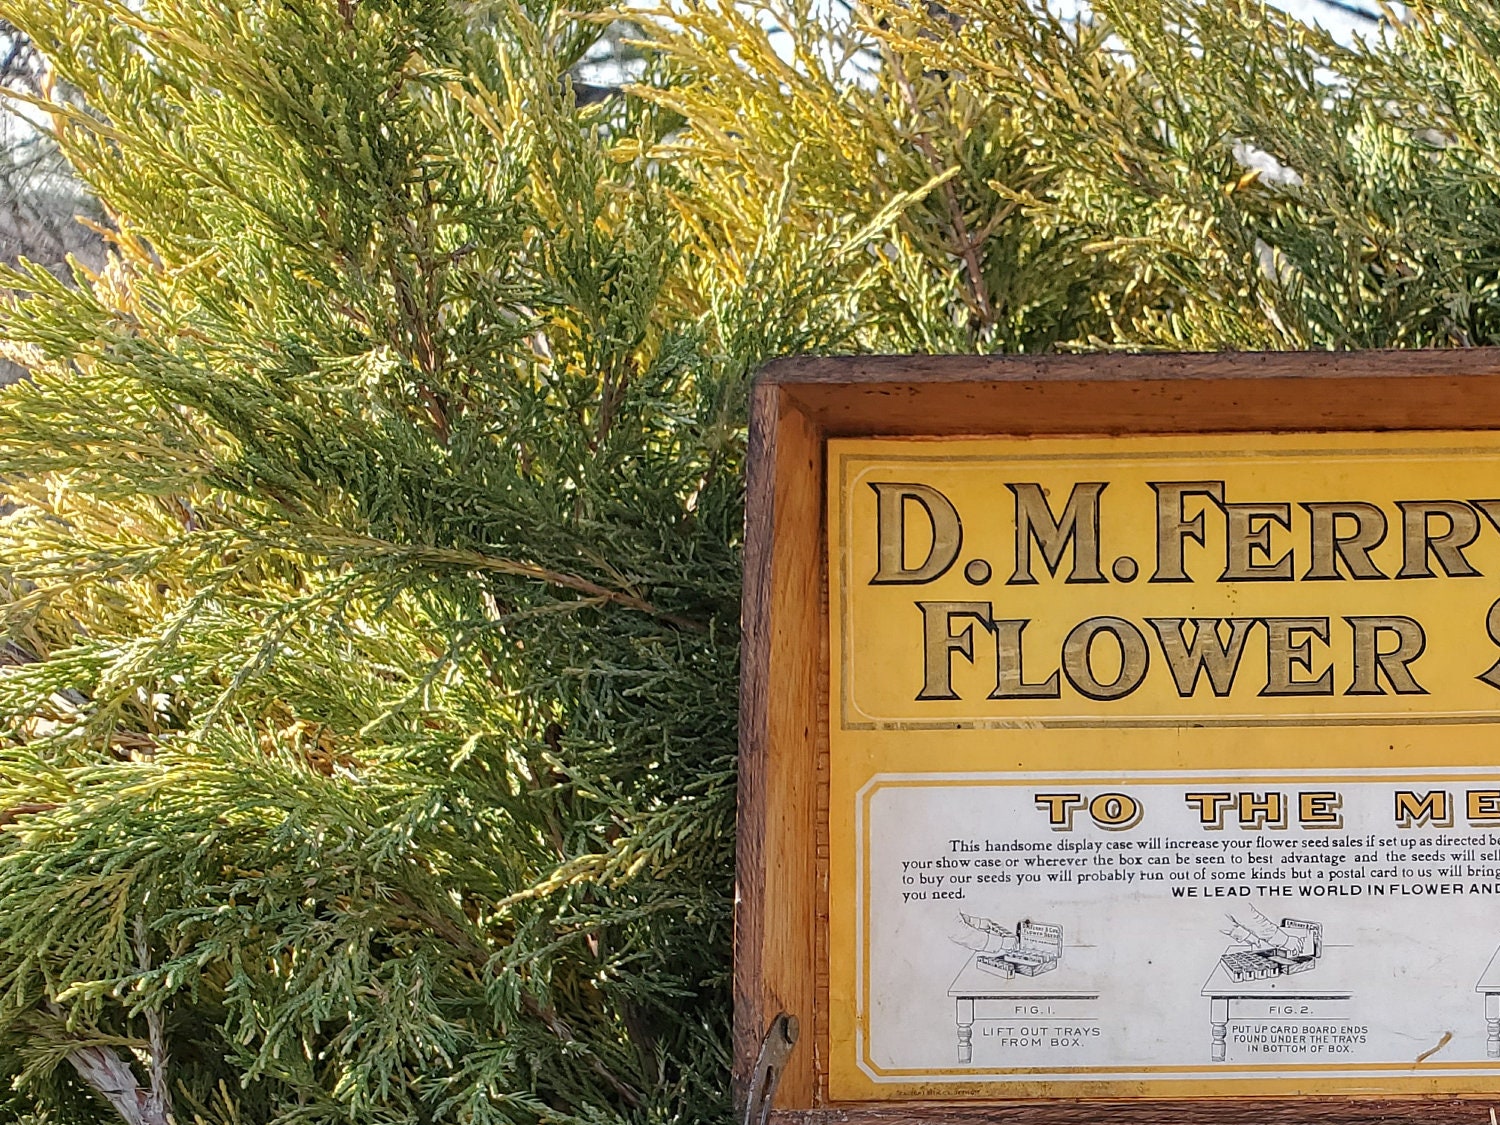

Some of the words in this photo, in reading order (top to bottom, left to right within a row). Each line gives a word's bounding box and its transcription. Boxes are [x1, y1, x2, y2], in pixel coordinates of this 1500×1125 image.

[914, 599, 1430, 702] FLOWER
[1034, 792, 1144, 832] TO
[1185, 791, 1343, 831] THE
[949, 840, 980, 852] This
[985, 839, 1052, 851] handsome
[1057, 838, 1103, 854] display
[1106, 841, 1133, 850] case
[1137, 837, 1161, 849] will
[1165, 837, 1219, 849] increase
[1221, 839, 1253, 852] your
[1256, 835, 1298, 847] flower
[1301, 835, 1329, 847] seed
[1332, 835, 1363, 847] sales
[1366, 834, 1376, 846] if
[1378, 836, 1398, 846] set
[1400, 837, 1417, 849] up
[1419, 836, 1433, 845] as
[1435, 833, 1486, 845] directed
[902, 860, 933, 872] your
[935, 856, 971, 868] show
[974, 859, 1001, 868] case
[1005, 858, 1019, 867] or
[1024, 855, 1088, 867] wherever
[1093, 854, 1113, 866] the
[1119, 854, 1143, 866] box
[1147, 856, 1170, 865] can
[1175, 853, 1191, 865] be
[1195, 856, 1225, 865] seen
[1231, 854, 1243, 864] to
[1247, 852, 1273, 864] best
[1280, 851, 1346, 867] advantage
[1354, 850, 1378, 862] and
[1386, 850, 1406, 862] the
[1411, 850, 1446, 862] seeds
[1450, 849, 1475, 861] will
[1480, 849, 1500, 861] sell
[902, 874, 914, 885] to
[919, 872, 944, 888] buy
[949, 875, 973, 884] our
[977, 871, 1012, 883] seeds
[1016, 874, 1041, 886] you
[1047, 870, 1072, 882] will
[1077, 870, 1135, 885] probably
[1139, 872, 1164, 881] run
[1169, 870, 1189, 881] out
[1193, 868, 1206, 880] of
[1211, 871, 1246, 880] some
[1250, 868, 1286, 880] kinds
[1291, 867, 1312, 879] but
[1317, 870, 1324, 879] a
[1329, 866, 1366, 882] postal
[1370, 866, 1398, 878] card
[1401, 867, 1414, 878] to
[1417, 868, 1432, 877] us
[1438, 865, 1462, 877] will
[902, 890, 927, 903] you
[1171, 886, 1198, 897] WE
[1203, 885, 1251, 896] LEAD
[1256, 885, 1293, 896] THE
[1298, 884, 1362, 895] WORLD
[1367, 884, 1385, 895] IN
[1390, 883, 1464, 895] FLOWER
[982, 1028, 1016, 1037] LIFT
[1020, 1028, 1051, 1037] OUT
[1055, 1028, 1102, 1037] TRAYS
[1231, 1024, 1252, 1034] PUT
[1253, 1024, 1268, 1034] UP
[1270, 1024, 1298, 1034] CARD
[1301, 1024, 1336, 1034] BOARD
[1339, 1024, 1369, 1034] ENDS
[1000, 1038, 1044, 1047] FROM
[1233, 1034, 1268, 1044] FOUND
[1271, 1034, 1306, 1044] UNDER
[1309, 1034, 1329, 1044] THE
[1332, 1034, 1368, 1044] TRAYS
[1247, 1044, 1259, 1053] IN
[1263, 1044, 1307, 1053] BOTTOM
[1310, 1044, 1324, 1053] OF
